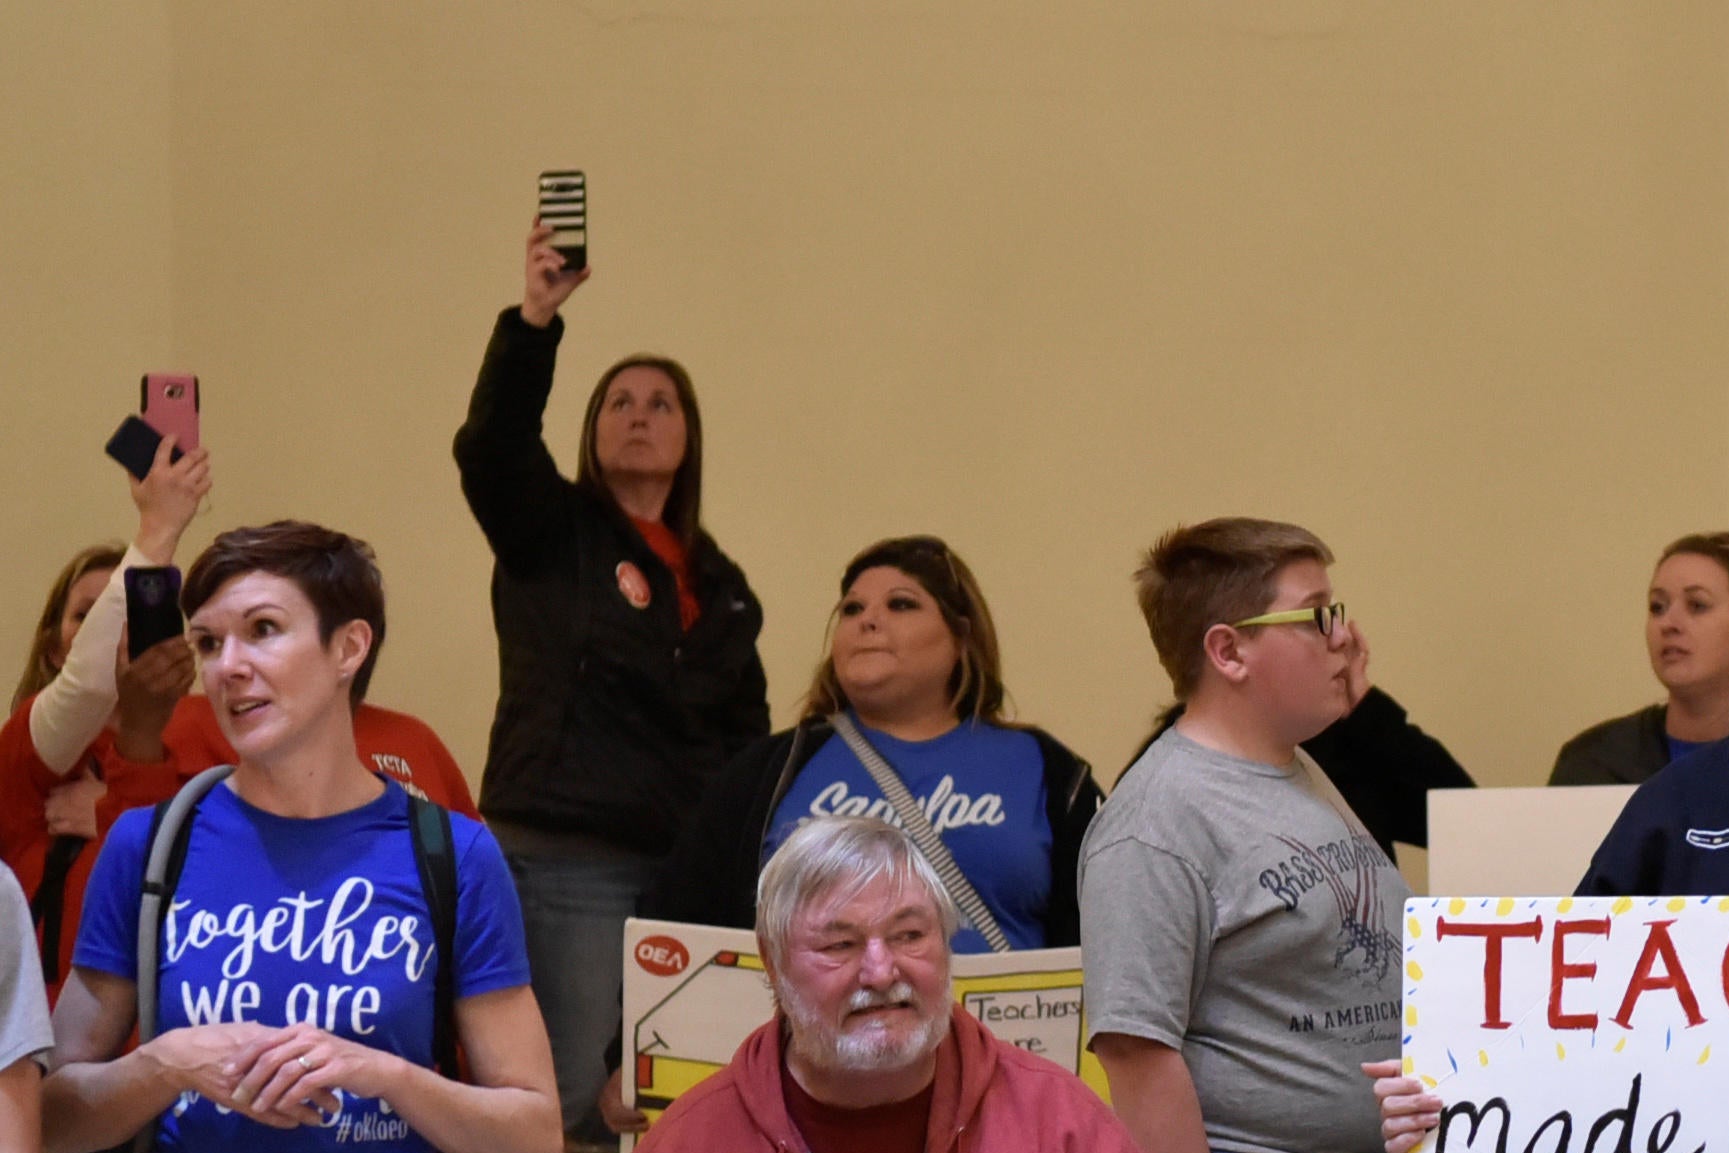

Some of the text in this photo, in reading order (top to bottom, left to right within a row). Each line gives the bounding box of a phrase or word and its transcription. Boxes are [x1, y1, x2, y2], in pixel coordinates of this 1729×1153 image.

[810, 774, 1005, 838] Saplpa
[165, 877, 436, 982] together
[638, 943, 683, 970] OEA
[181, 979, 381, 1035] we are
[968, 993, 1082, 1022] Teachers
[1289, 1013, 1314, 1032] AN
